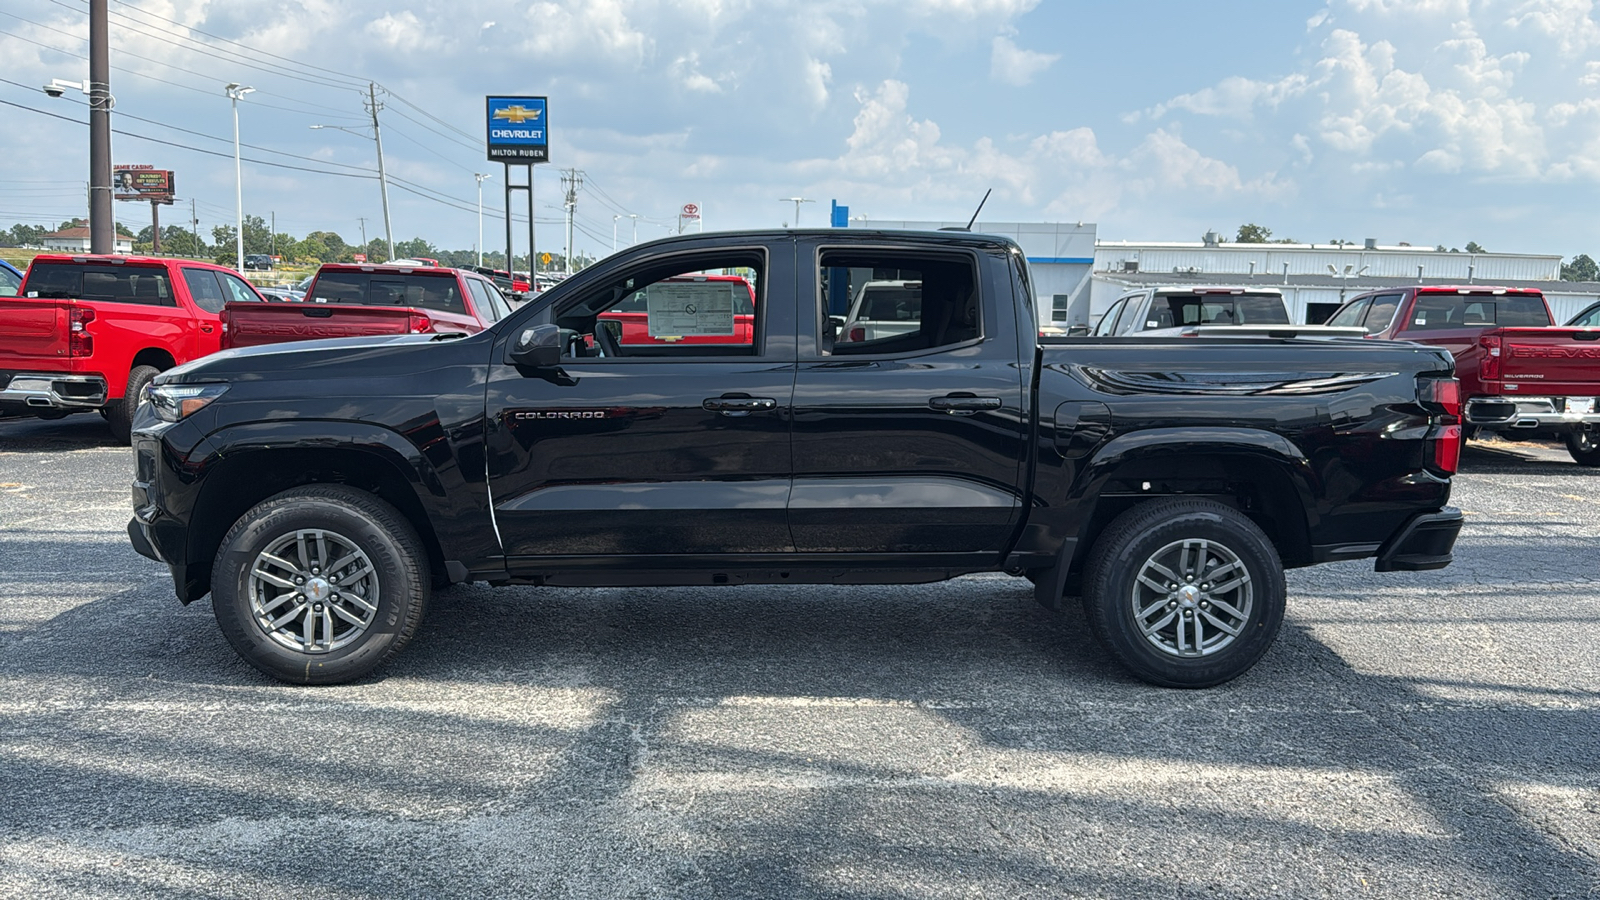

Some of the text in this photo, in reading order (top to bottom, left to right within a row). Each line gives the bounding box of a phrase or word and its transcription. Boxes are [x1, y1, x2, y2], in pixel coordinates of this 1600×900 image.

[492, 129, 543, 139] CHEVROLET
[519, 149, 544, 157] RUBEN
[1513, 346, 1600, 359] CHEVR
[514, 411, 605, 420] COLORADO
